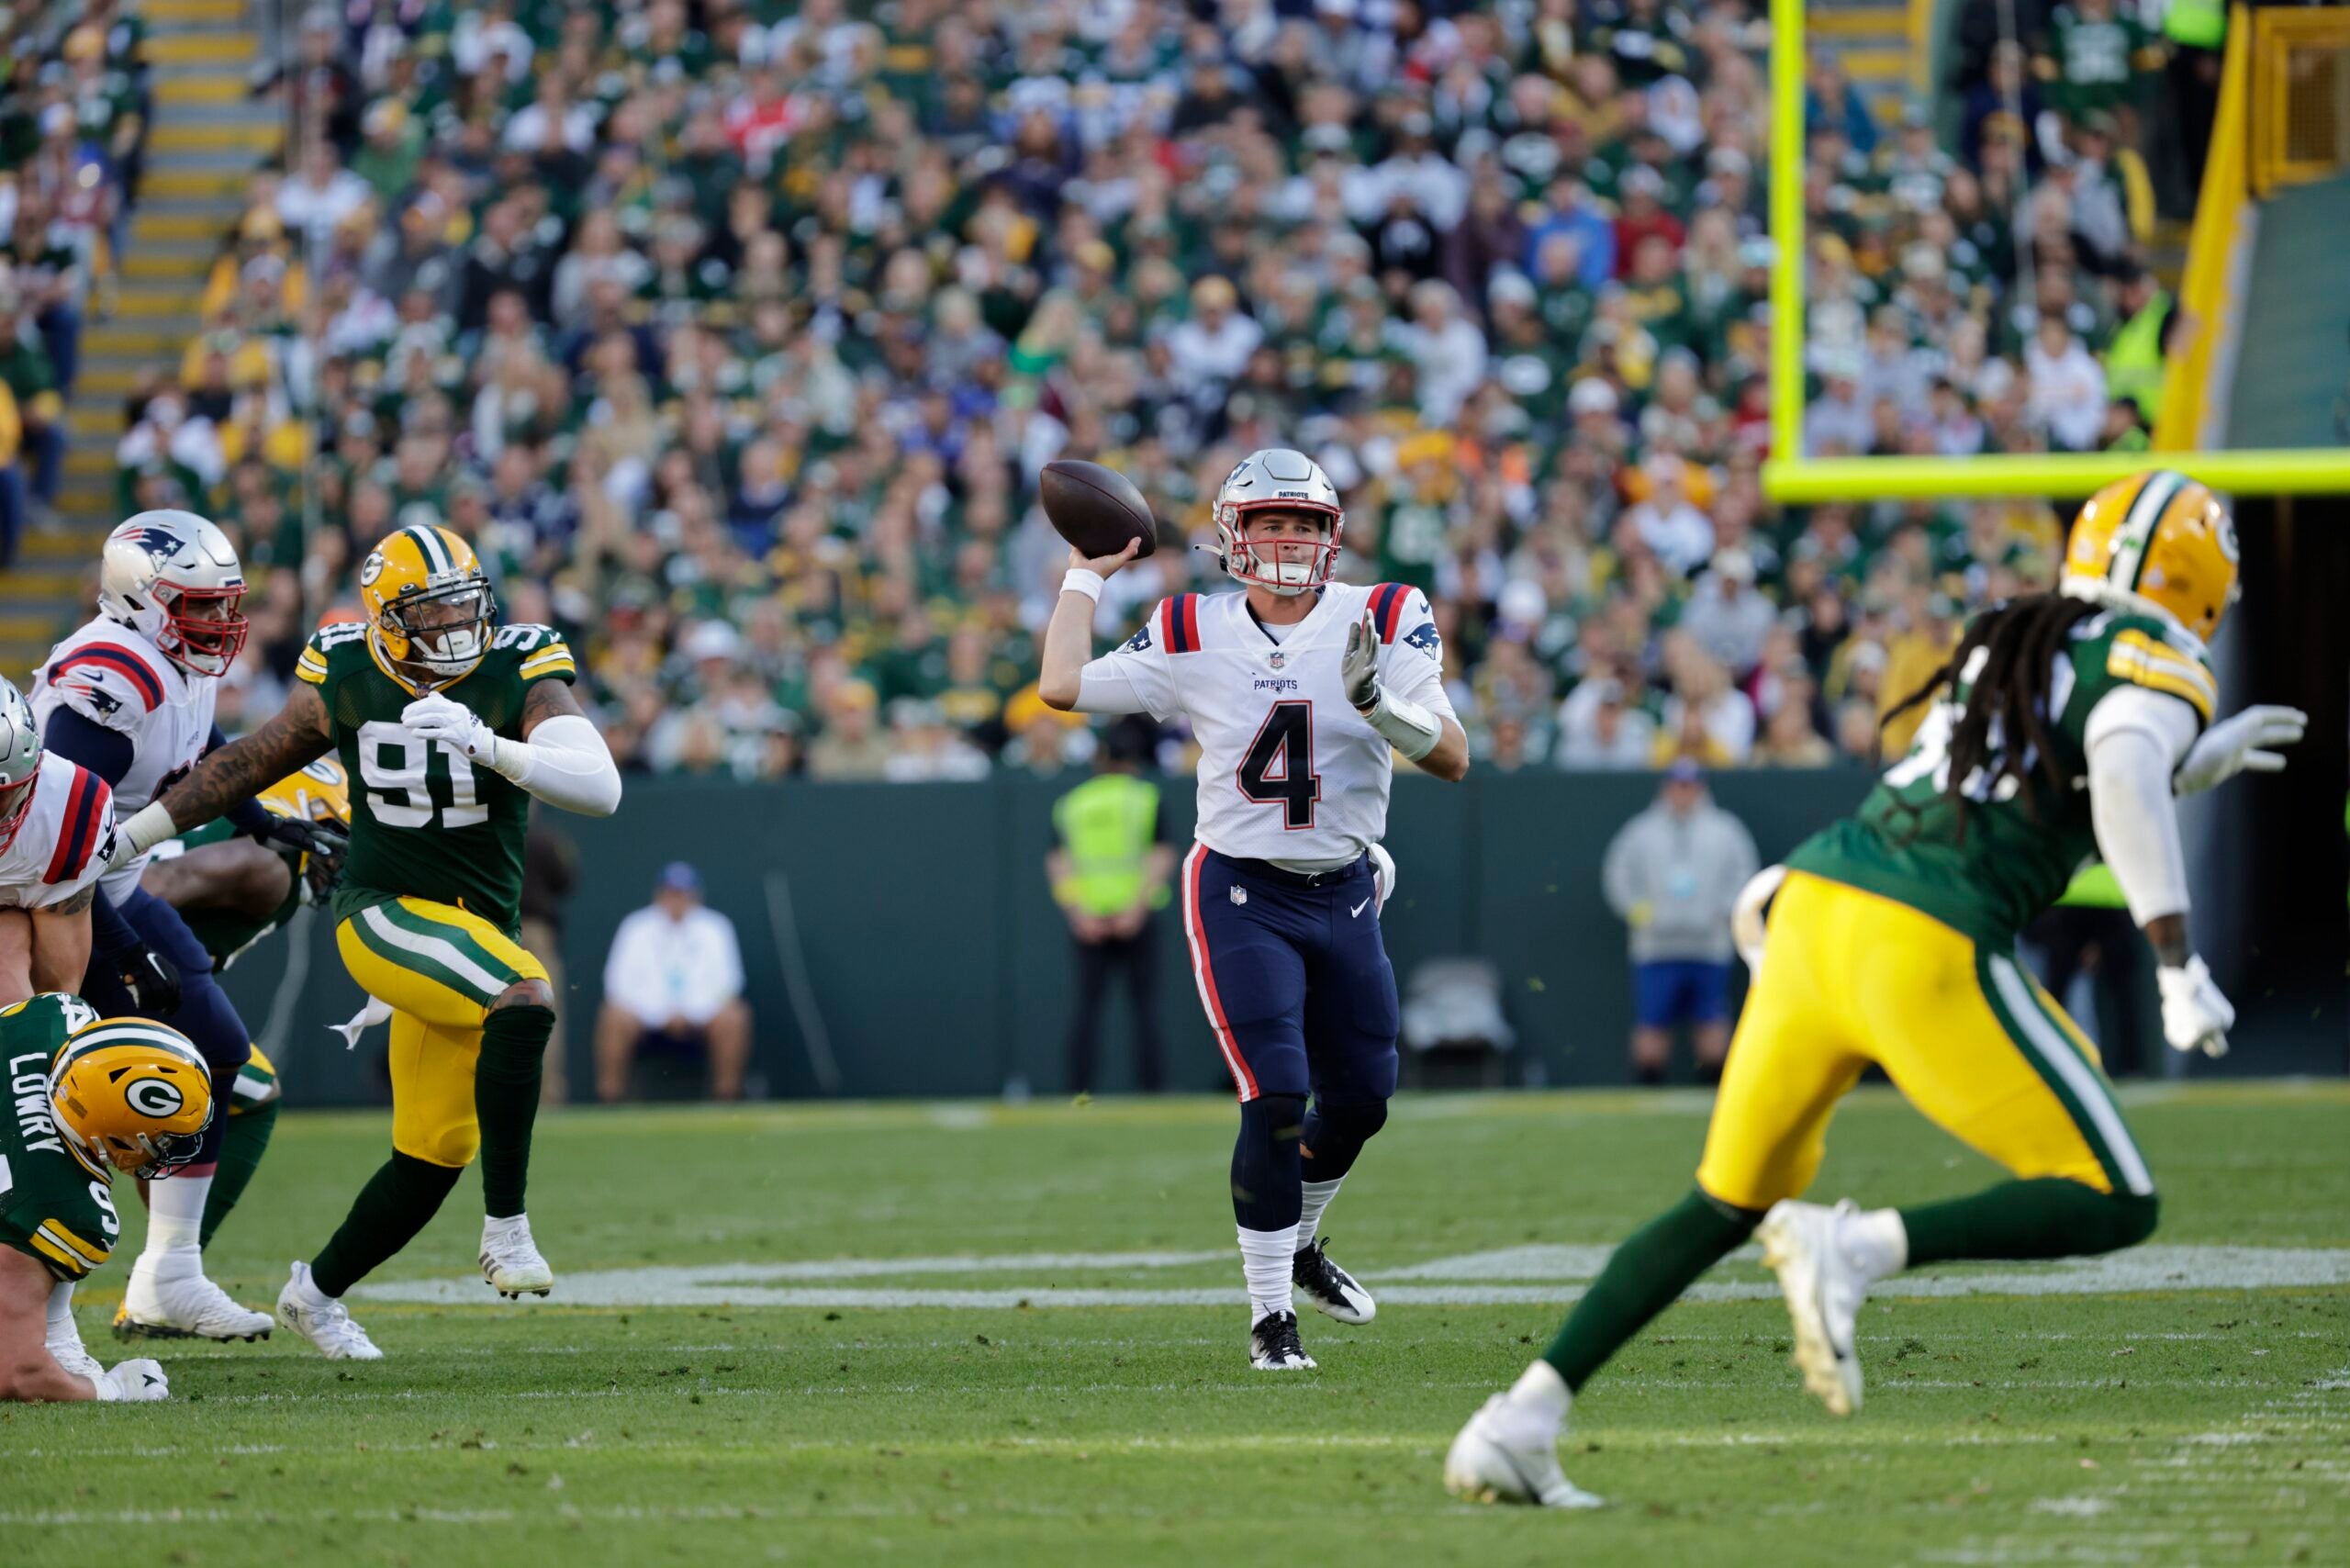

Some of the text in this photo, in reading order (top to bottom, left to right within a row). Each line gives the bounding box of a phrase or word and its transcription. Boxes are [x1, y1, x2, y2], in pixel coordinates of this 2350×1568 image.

[1279, 490, 1309, 500] PATRIOTS
[1254, 679, 1298, 691] PATRIOTS
[356, 719, 488, 828] 91
[1237, 700, 1321, 831] 4
[9, 1051, 65, 1155] LOWRY
[126, 1078, 183, 1118] G
